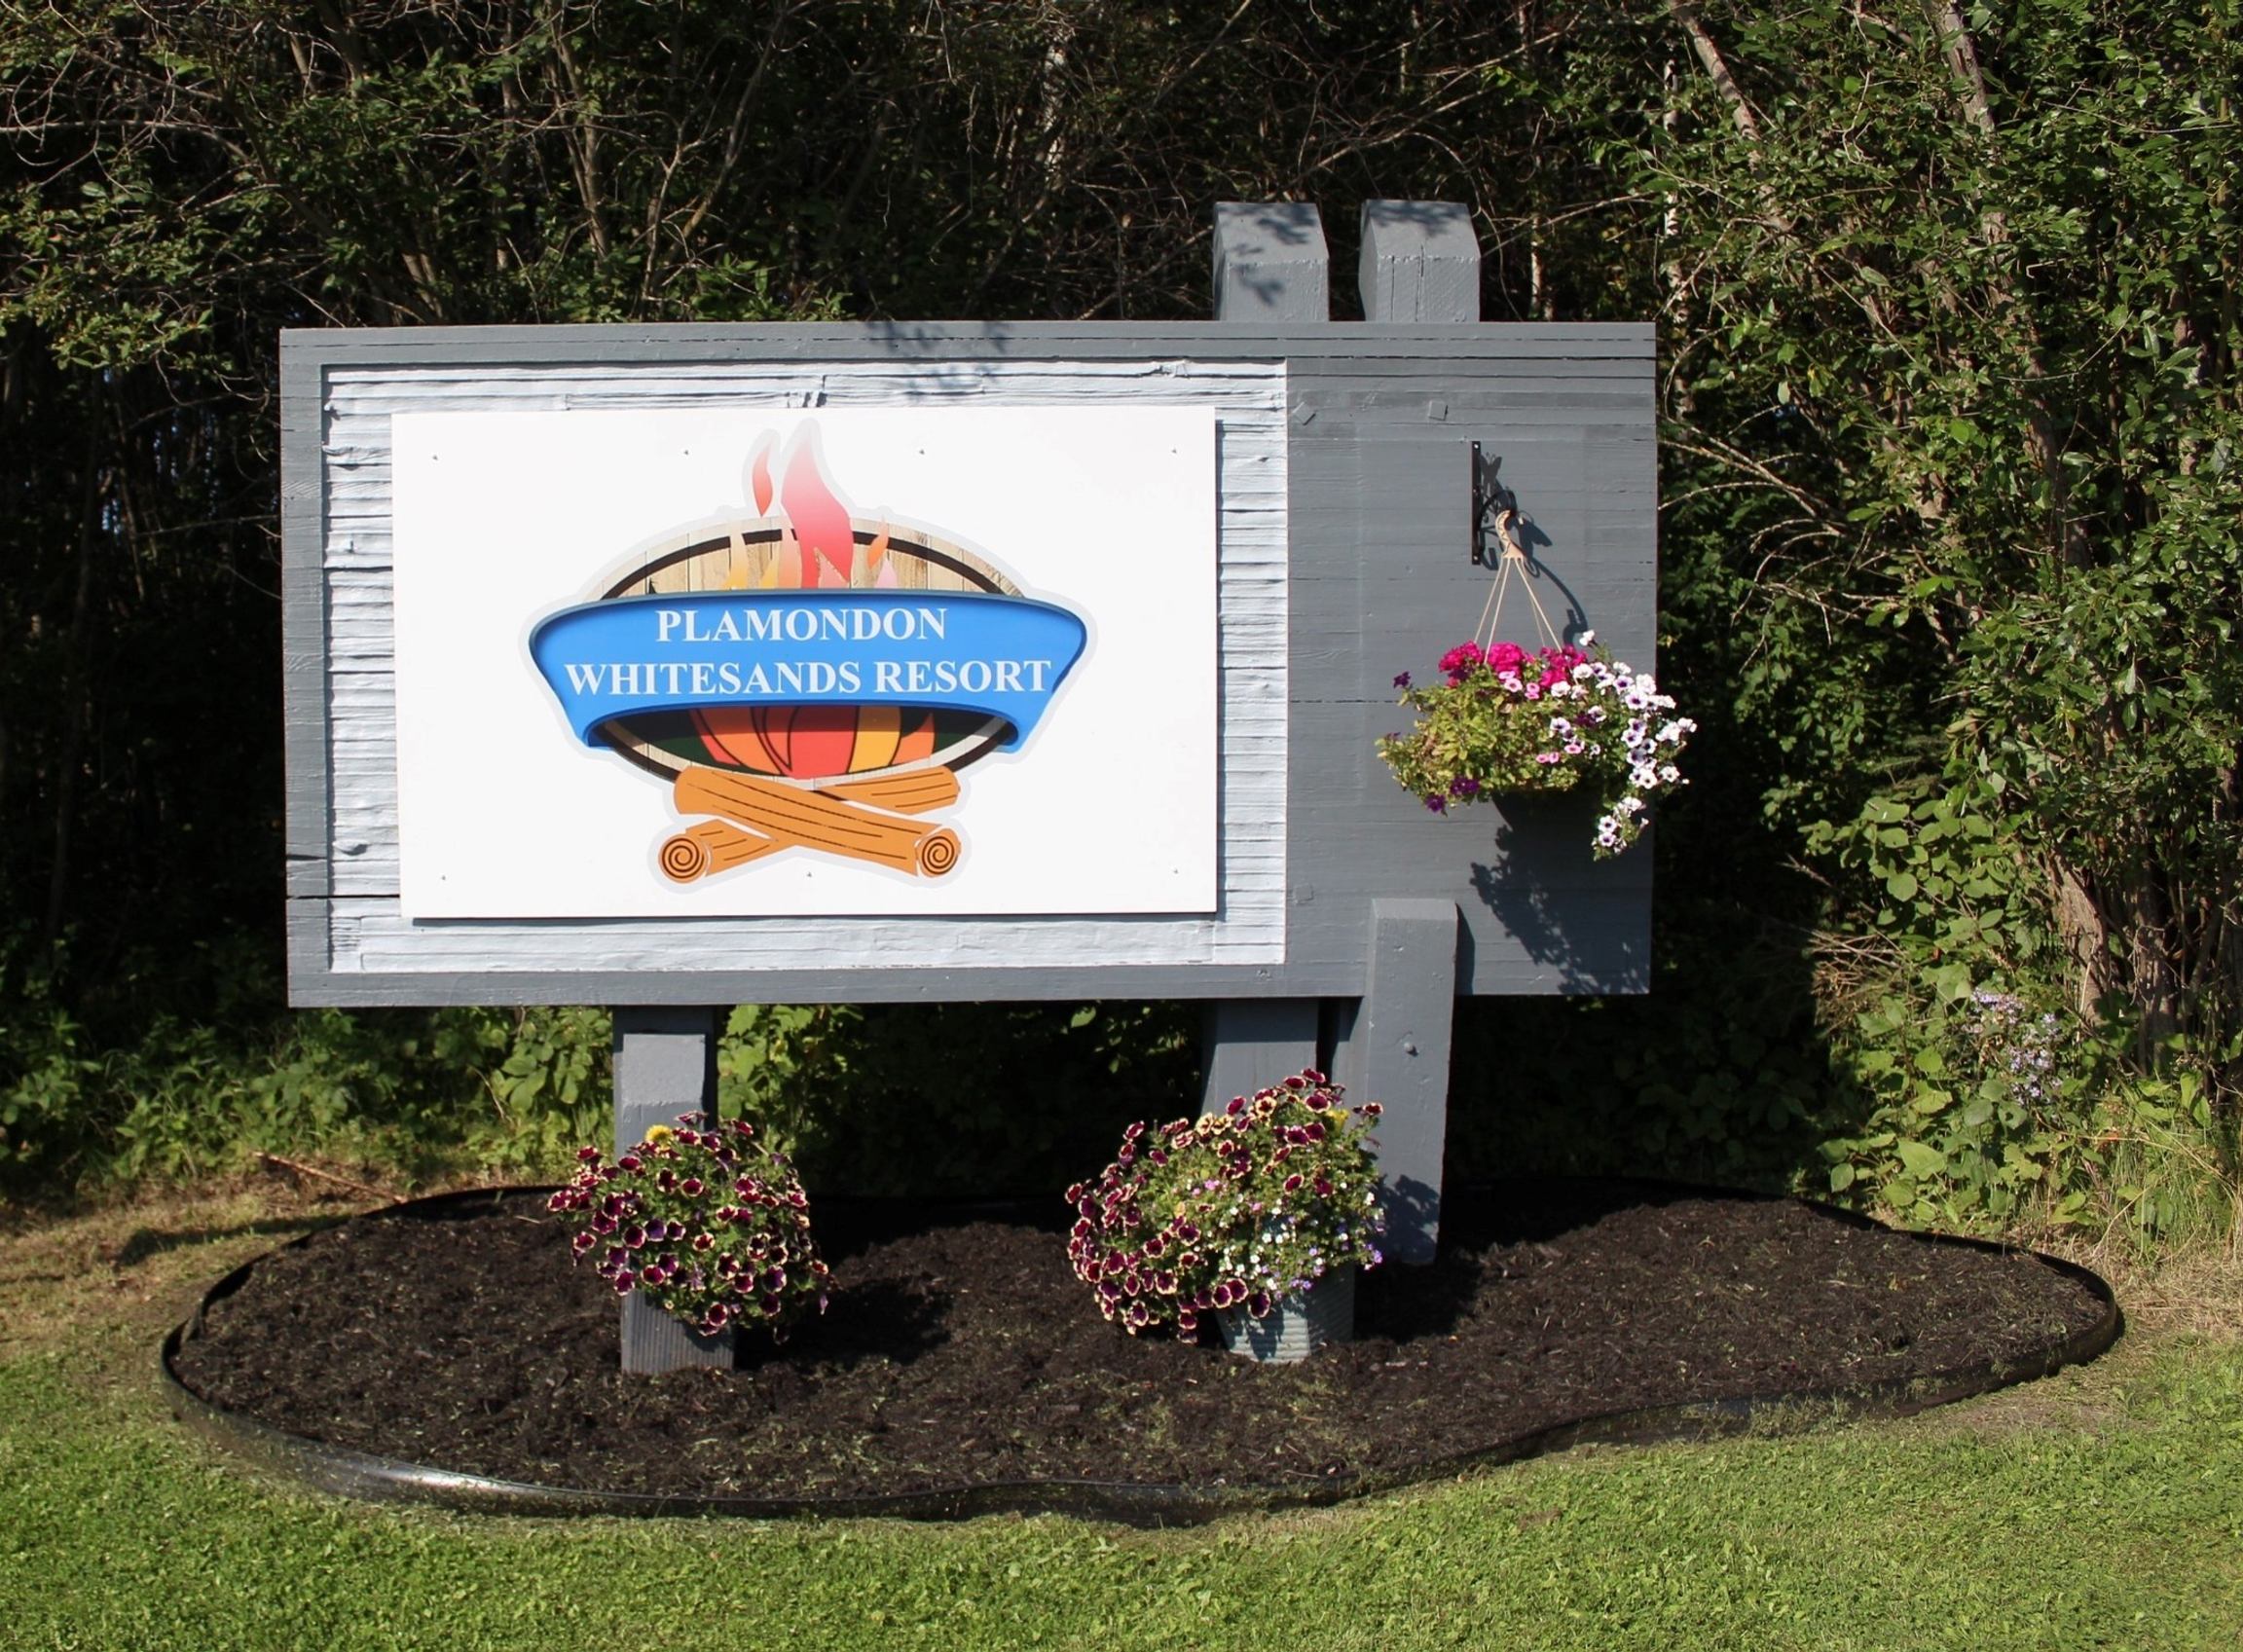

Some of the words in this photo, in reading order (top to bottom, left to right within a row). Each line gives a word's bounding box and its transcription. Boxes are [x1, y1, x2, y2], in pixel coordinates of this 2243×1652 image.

[656, 607, 948, 642] PLAMONDON
[564, 661, 863, 696] WHITESANDS
[873, 659, 1052, 694] RESORT
